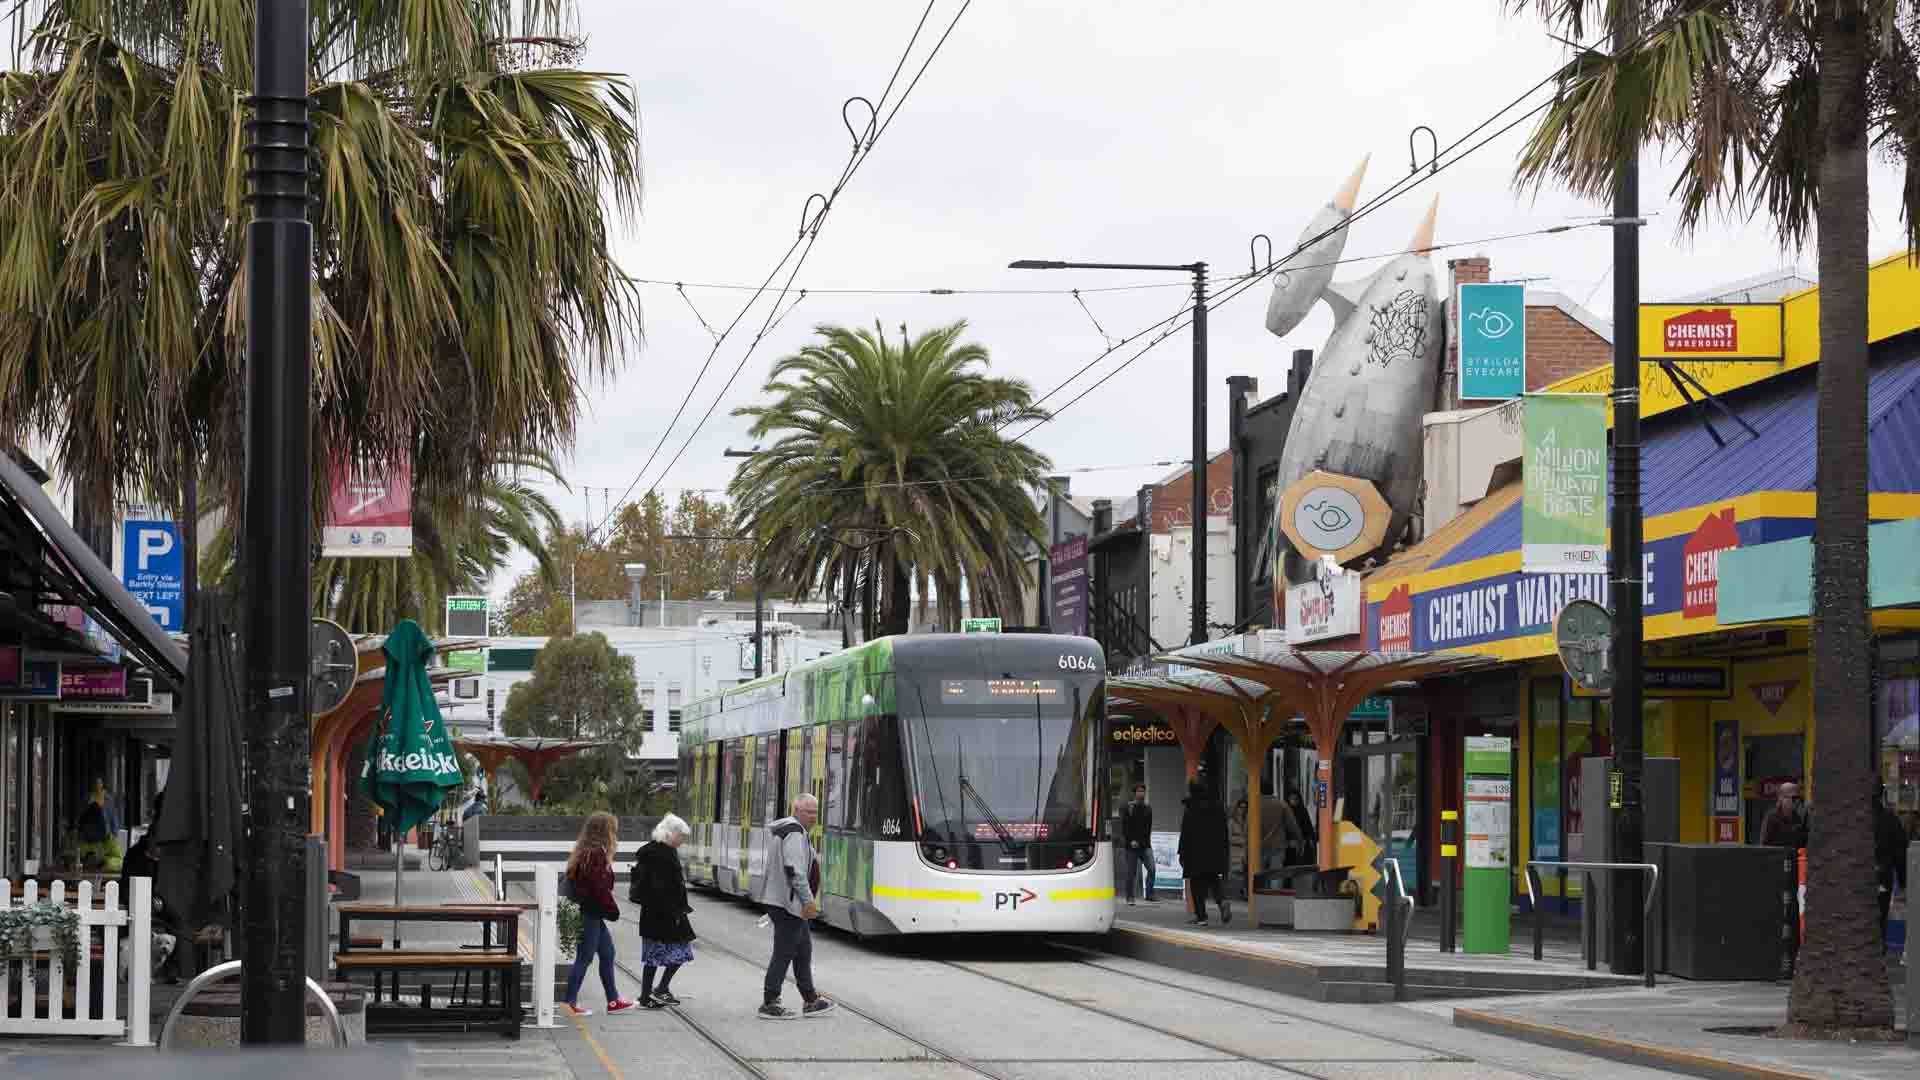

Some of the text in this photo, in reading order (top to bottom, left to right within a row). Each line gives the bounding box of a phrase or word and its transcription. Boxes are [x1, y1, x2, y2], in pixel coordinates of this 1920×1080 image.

[1667, 323, 1735, 339] CHEMIST
[1667, 340, 1733, 348] WAREHOUSE
[1465, 367, 1520, 376] EYECARE
[1541, 427, 1557, 446] A
[138, 529, 174, 570] P
[136, 591, 181, 600] EXT LEFT
[1428, 583, 1508, 643] CHEMIST
[1380, 612, 1410, 641] CHEMIST
[1058, 655, 1097, 671] 6064
[882, 818, 901, 835] 6064
